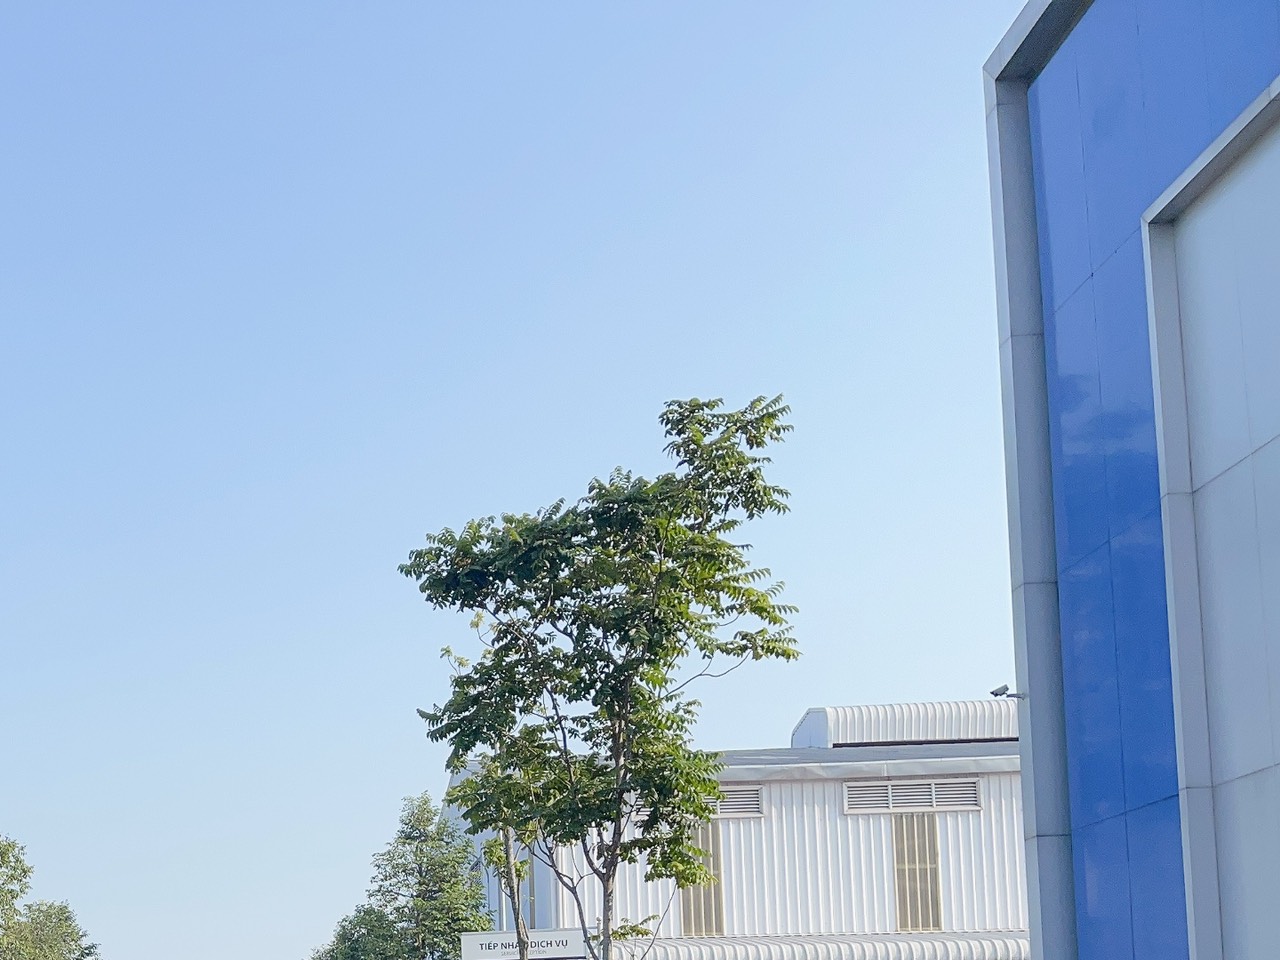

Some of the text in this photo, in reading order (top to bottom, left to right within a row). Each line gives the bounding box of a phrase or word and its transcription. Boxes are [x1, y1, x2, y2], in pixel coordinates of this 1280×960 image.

[501, 941, 520, 950] NH
[530, 940, 553, 950] DỊCH
[555, 939, 568, 950] VỤ
